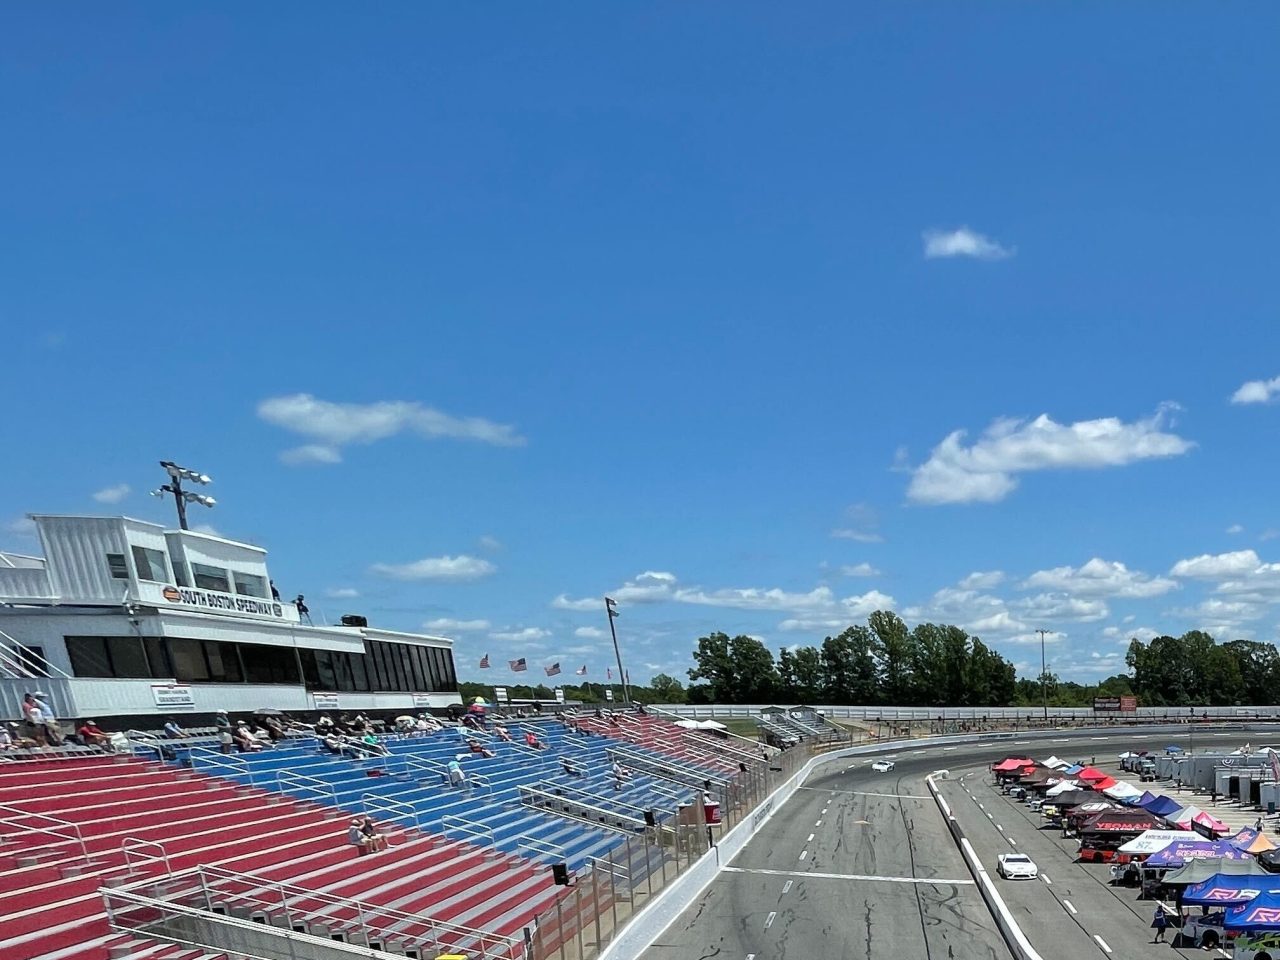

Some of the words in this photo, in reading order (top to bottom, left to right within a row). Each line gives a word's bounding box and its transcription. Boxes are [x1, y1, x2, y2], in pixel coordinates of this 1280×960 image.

[180, 590, 206, 606] SOUTH
[206, 593, 236, 611] BOSTON
[236, 598, 273, 616] SPEEDWAY
